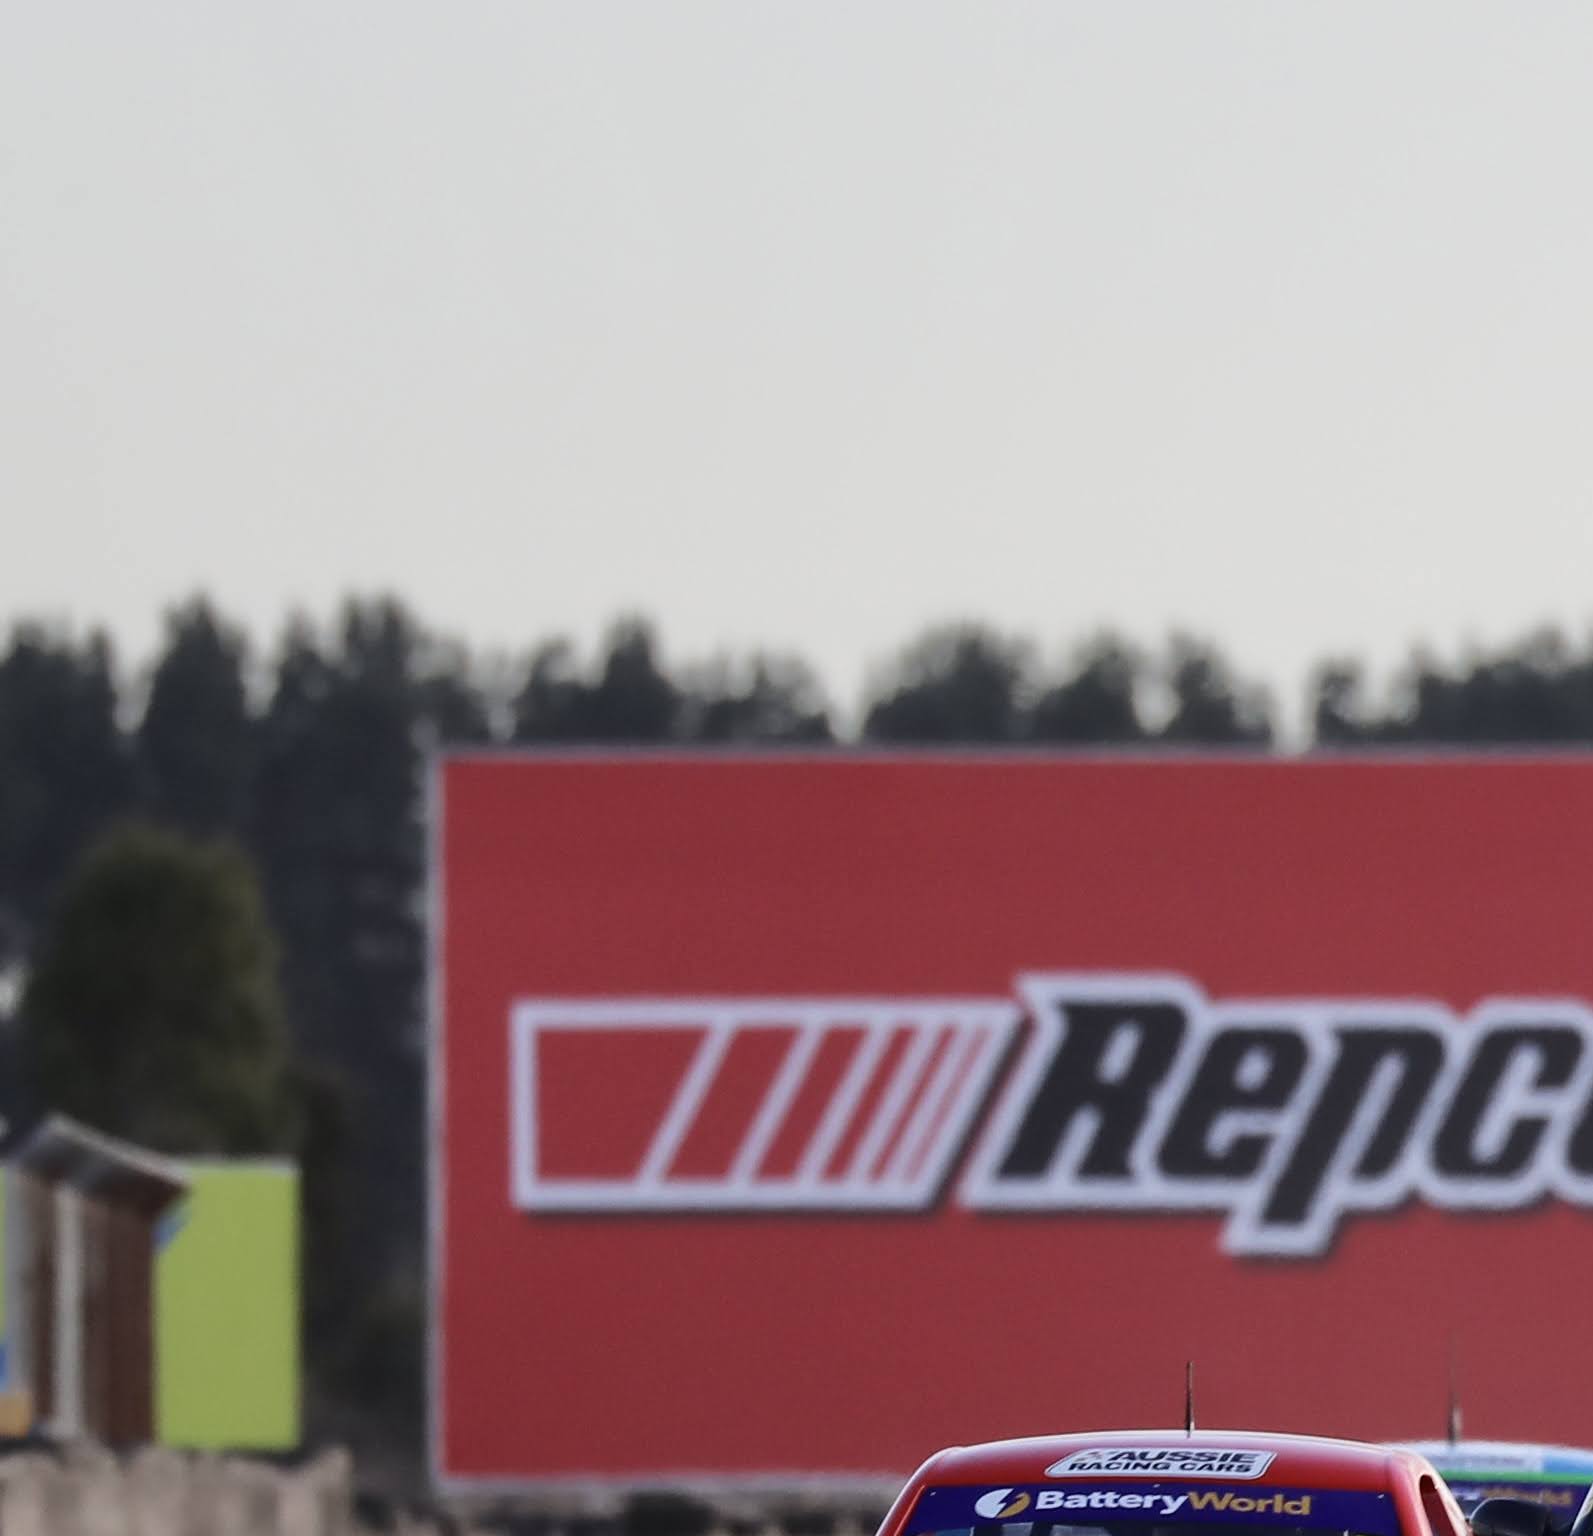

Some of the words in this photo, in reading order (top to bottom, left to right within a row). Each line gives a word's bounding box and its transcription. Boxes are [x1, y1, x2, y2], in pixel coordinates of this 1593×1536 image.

[1106, 1450, 1257, 1464] AUSSIE
[1067, 1461, 1170, 1472] RACING
[1179, 1462, 1253, 1474] CARS
